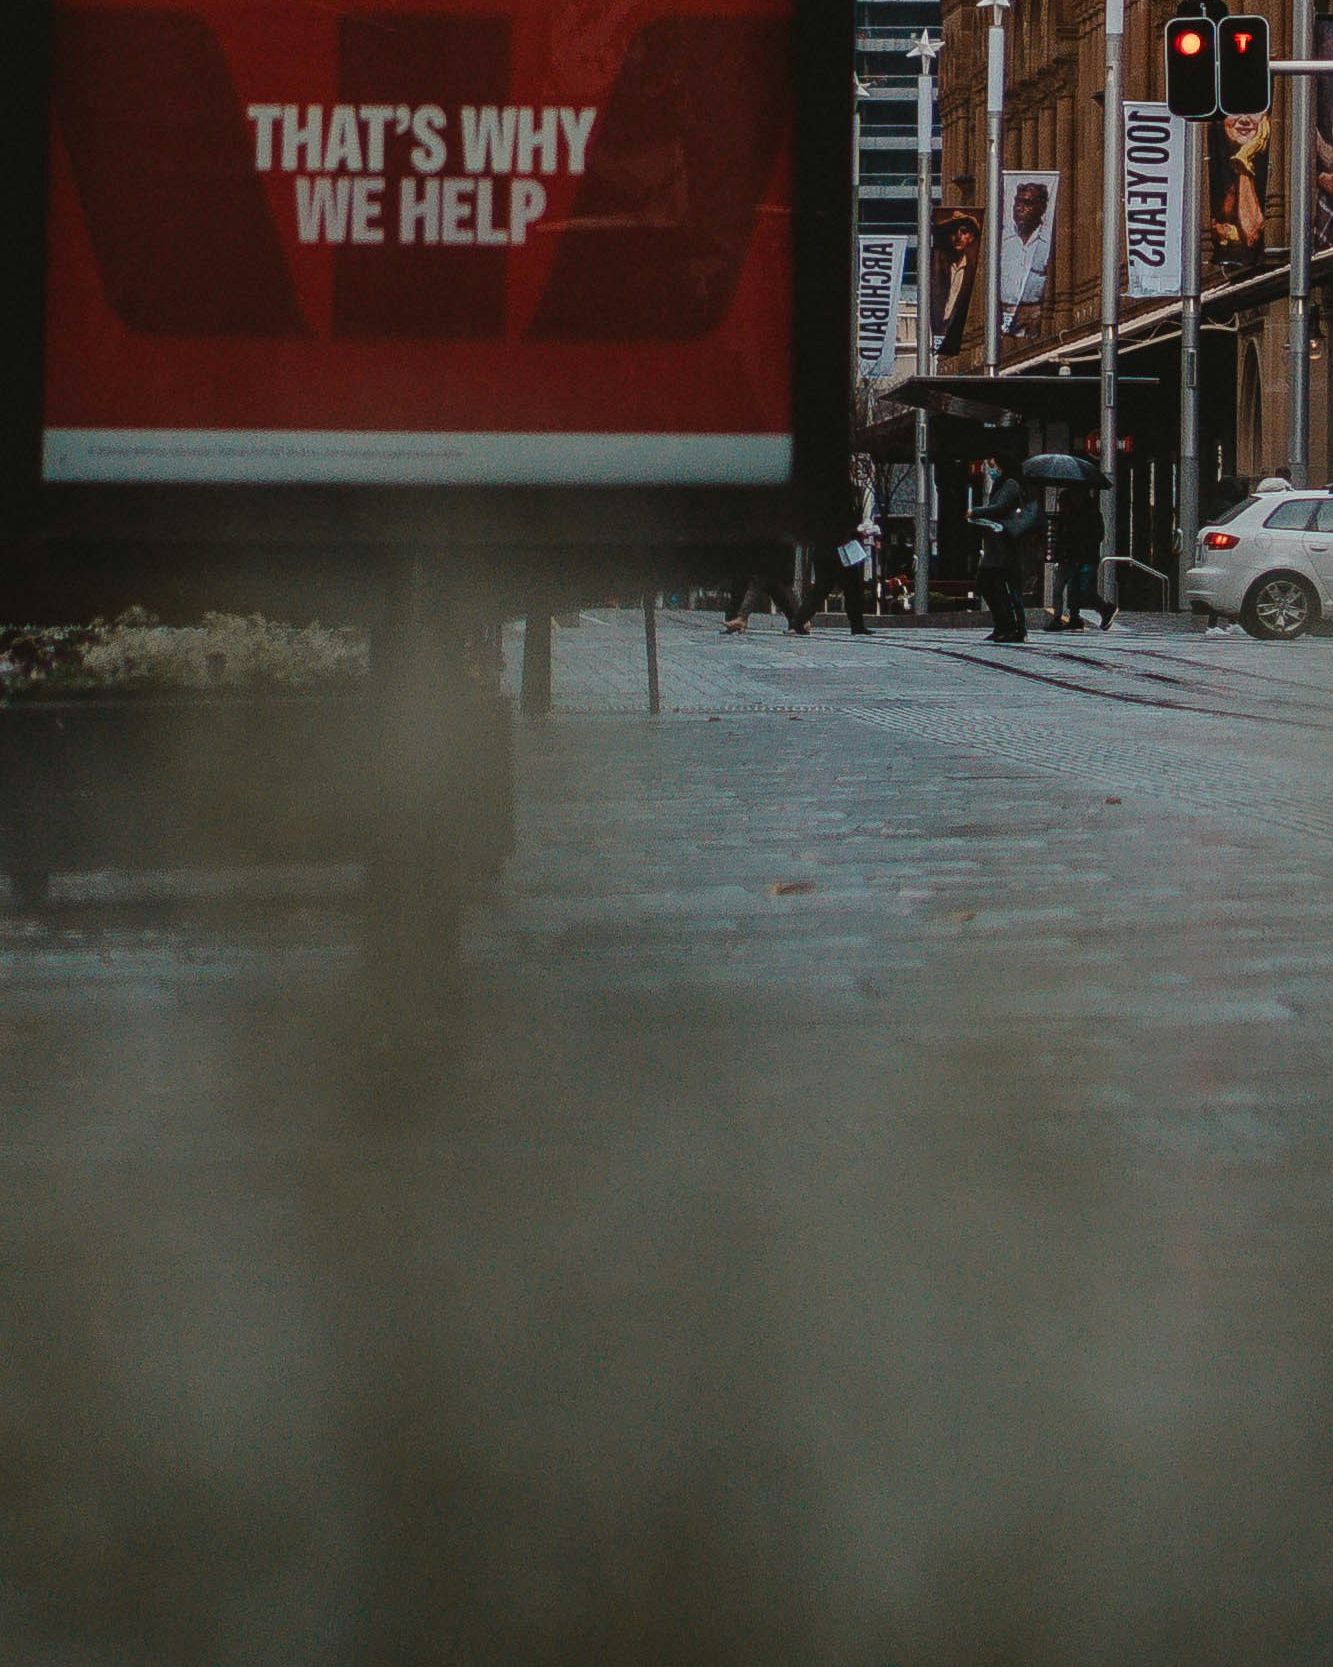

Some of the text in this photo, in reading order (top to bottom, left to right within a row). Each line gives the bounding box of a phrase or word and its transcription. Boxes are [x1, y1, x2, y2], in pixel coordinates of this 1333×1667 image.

[247, 103, 599, 174] THAT'S WHY
[295, 178, 547, 247] WE HELP
